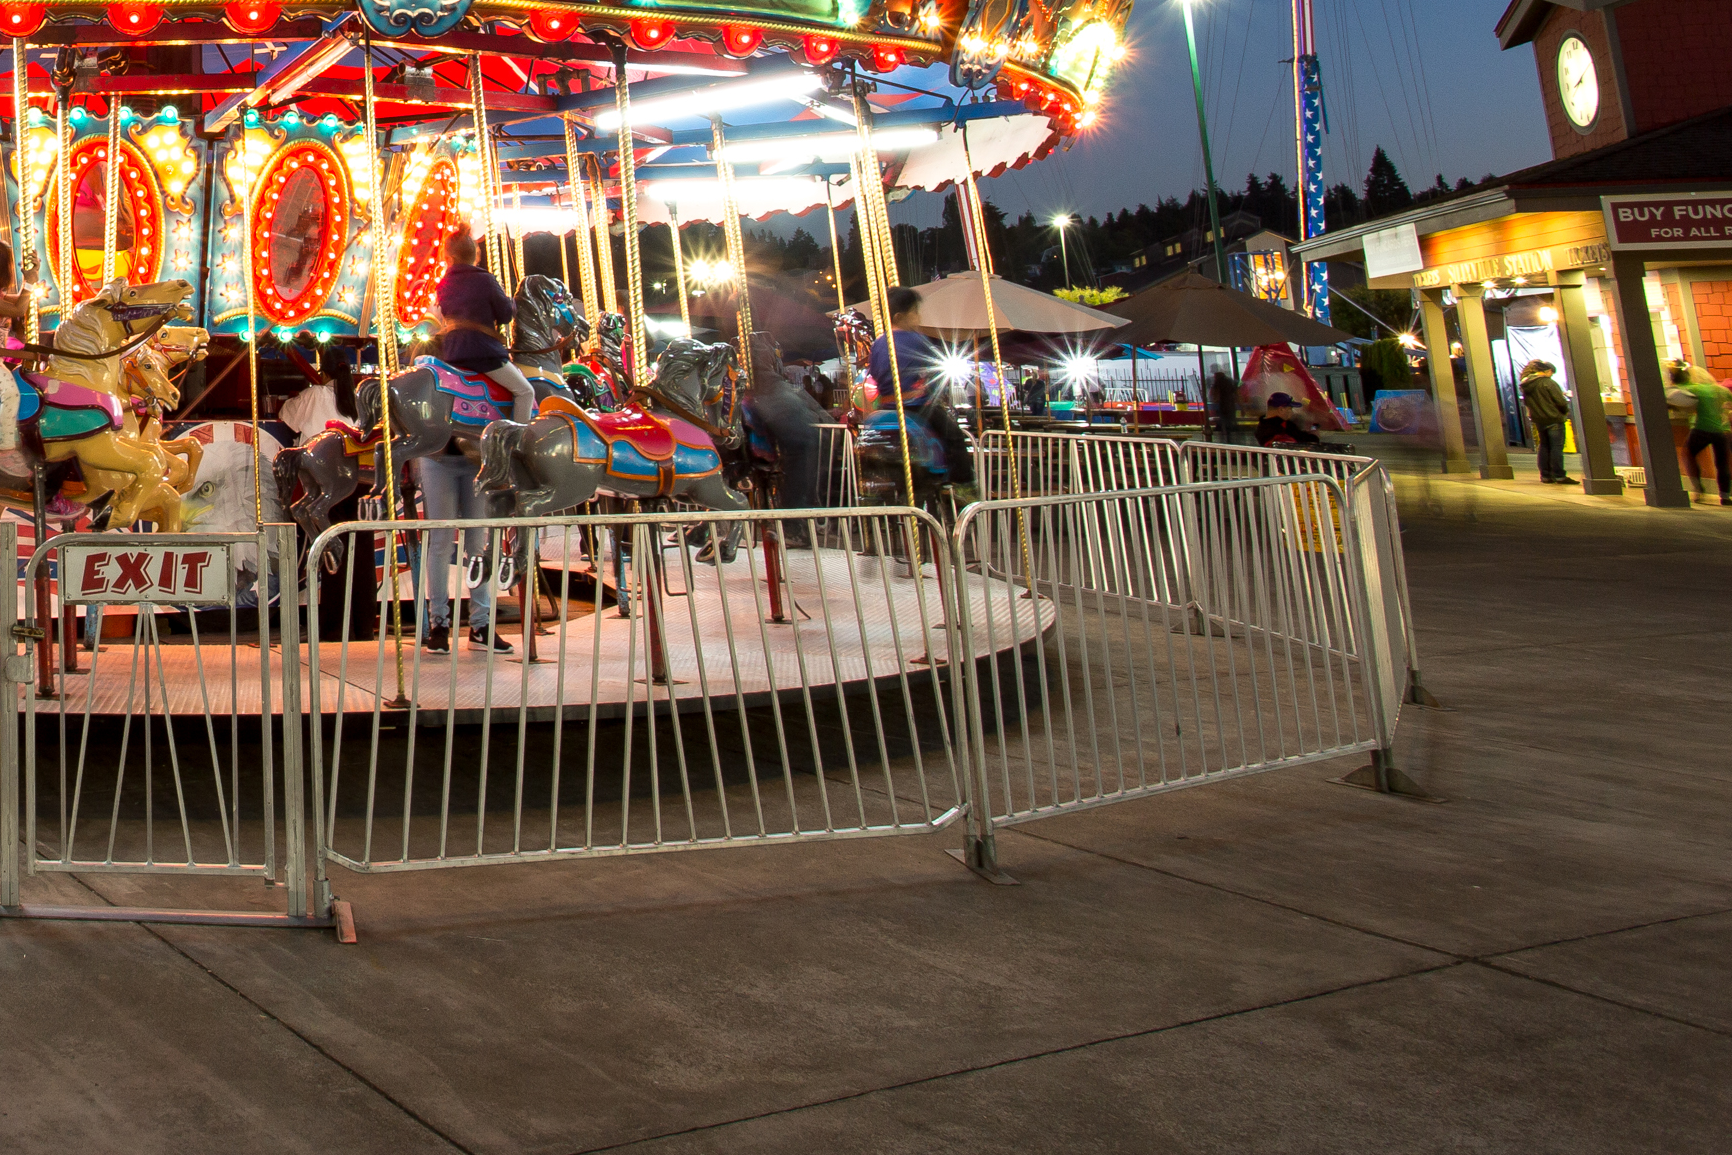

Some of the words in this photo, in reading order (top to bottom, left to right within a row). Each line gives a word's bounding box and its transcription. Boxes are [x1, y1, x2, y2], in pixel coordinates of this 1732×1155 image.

[1617, 206, 1665, 222] BUY
[1650, 227, 1684, 238] FOR
[1689, 226, 1720, 237] ALL
[1503, 249, 1554, 276] STATION
[81, 550, 212, 596] EXIT
